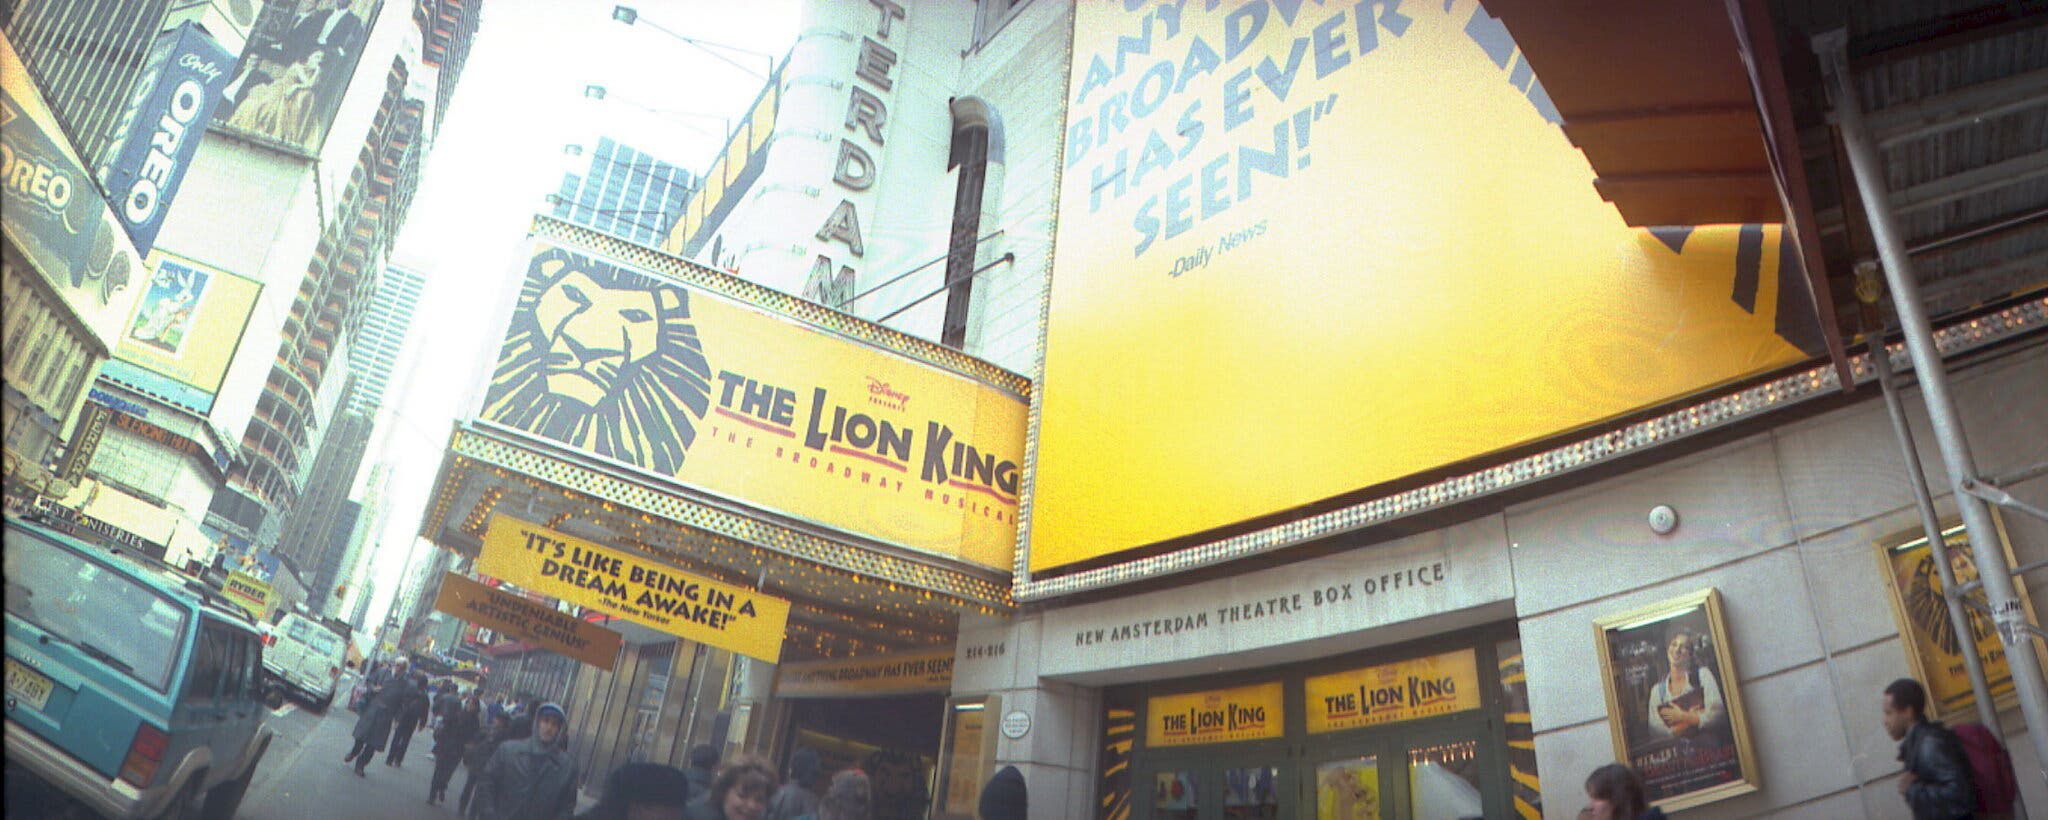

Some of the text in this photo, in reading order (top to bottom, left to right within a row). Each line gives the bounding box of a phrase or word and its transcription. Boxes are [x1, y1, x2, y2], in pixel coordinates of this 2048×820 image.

[178, 53, 222, 84] Only
[1076, 0, 1220, 104] ANY
[1090, 0, 1414, 214] HAS EVER
[125, 79, 204, 225] OREO
[1218, 219, 1268, 254] News
[718, 370, 797, 427] THE
[712, 426, 1014, 525] THE BROADWAY MUSICAL
[230, 579, 266, 600] RYDER
[521, 530, 757, 618] "IT'S LIKE BEING IN A
[541, 559, 628, 600] DREAM
[1076, 563, 1444, 646] NEW AMSTERDAM THEATRE BOX OFFICE
[1163, 713, 1187, 731] THE
[1324, 695, 1356, 714] THE
